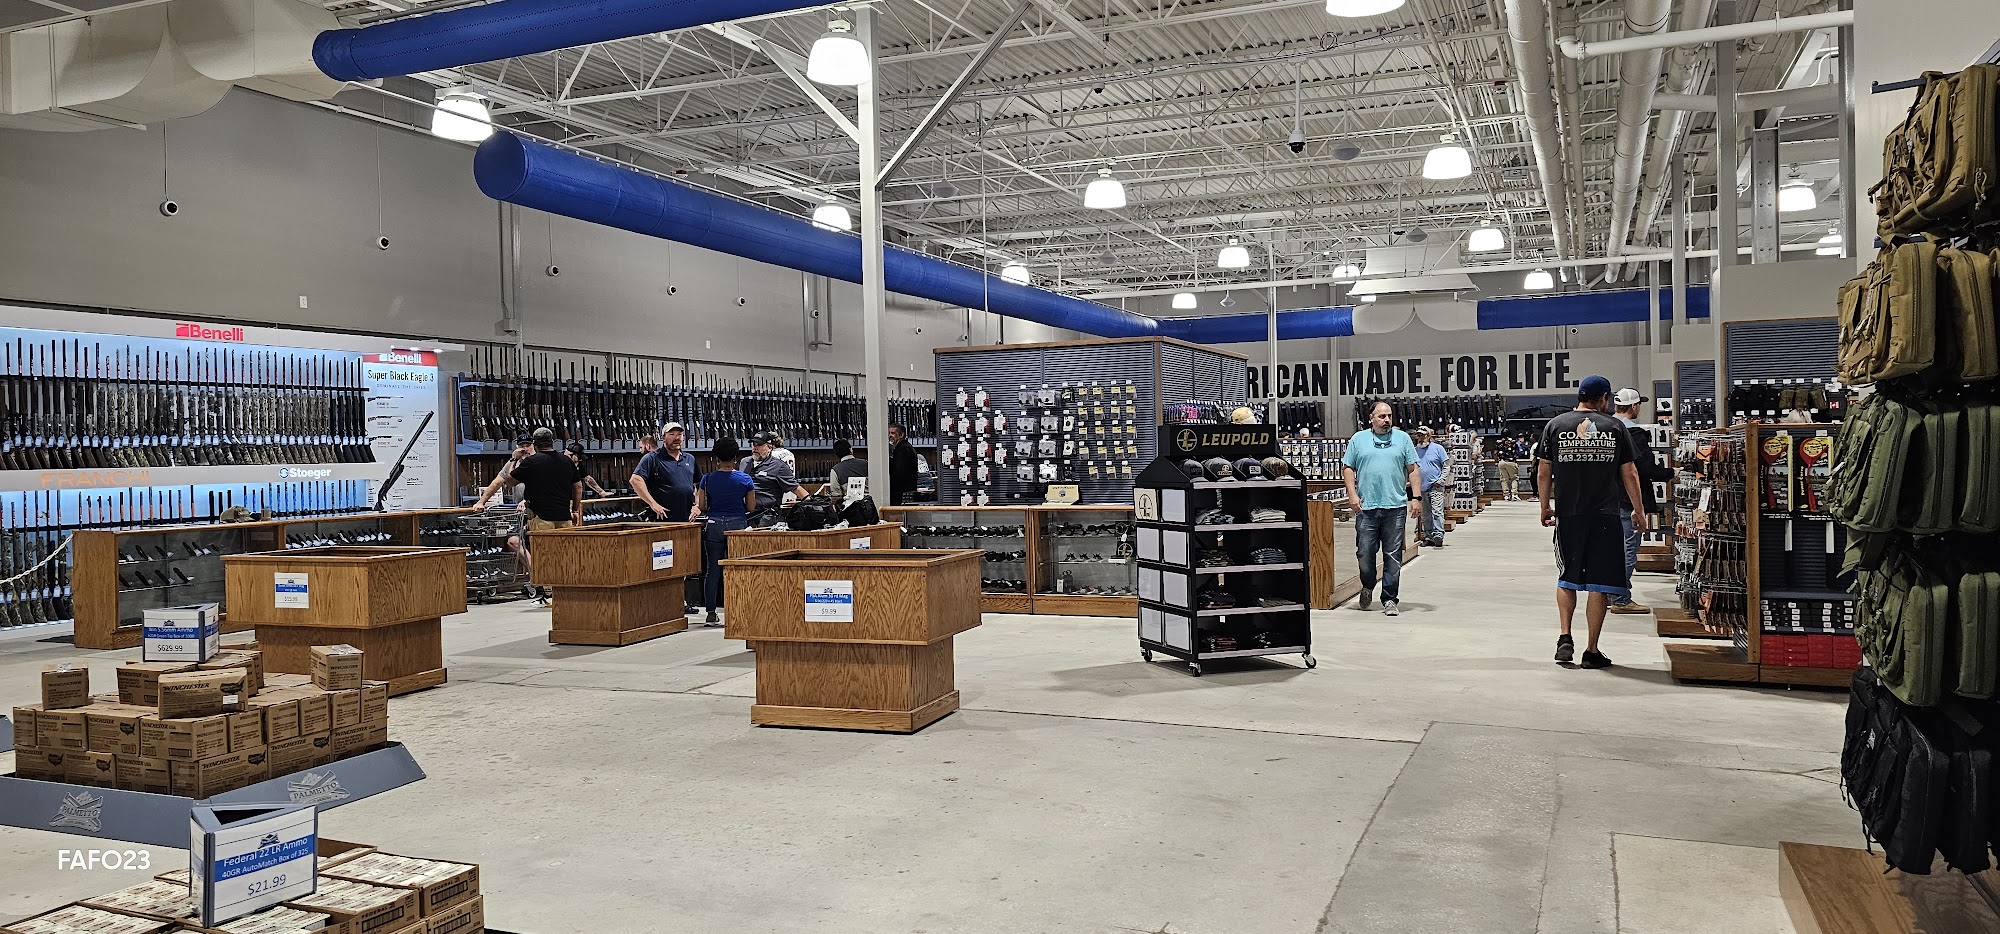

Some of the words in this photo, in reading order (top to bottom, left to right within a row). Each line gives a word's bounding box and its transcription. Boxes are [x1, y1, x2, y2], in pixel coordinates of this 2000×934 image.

[190, 324, 244, 341] Benelli
[388, 352, 422, 364] Benelli
[368, 370, 388, 381] Super
[390, 371, 409, 381] Black
[411, 372, 428, 383] Eagle
[430, 373, 434, 382] 3
[1340, 359, 1430, 395] MADE.
[1440, 356, 1497, 392] FOR
[1509, 352, 1579, 389] LIFE.
[1202, 432, 1269, 446] LEUPOLD
[1559, 431, 1616, 440] COASTAL
[41, 471, 150, 488] FRANCHI
[290, 468, 331, 479] Stoeger
[163, 683, 210, 691] WINCHESTER
[334, 726, 368, 738] WINCHESTER
[271, 739, 307, 751] WINCHESTER
[202, 755, 240, 769] WINCHESTER
[293, 781, 337, 799] PALMETTO
[62, 805, 98, 817] PALMETTO
[223, 851, 257, 867] Federal
[259, 848, 270, 858] 22
[271, 846, 281, 856] LR
[283, 838, 308, 851] Ammo
[222, 865, 241, 878] 40GR
[242, 858, 278, 873] AutoMatch
[279, 854, 290, 864] Box
[291, 852, 298, 861] of
[298, 848, 309, 858] 325
[247, 874, 287, 897] $21.99
[362, 905, 388, 919] FEDERAL
